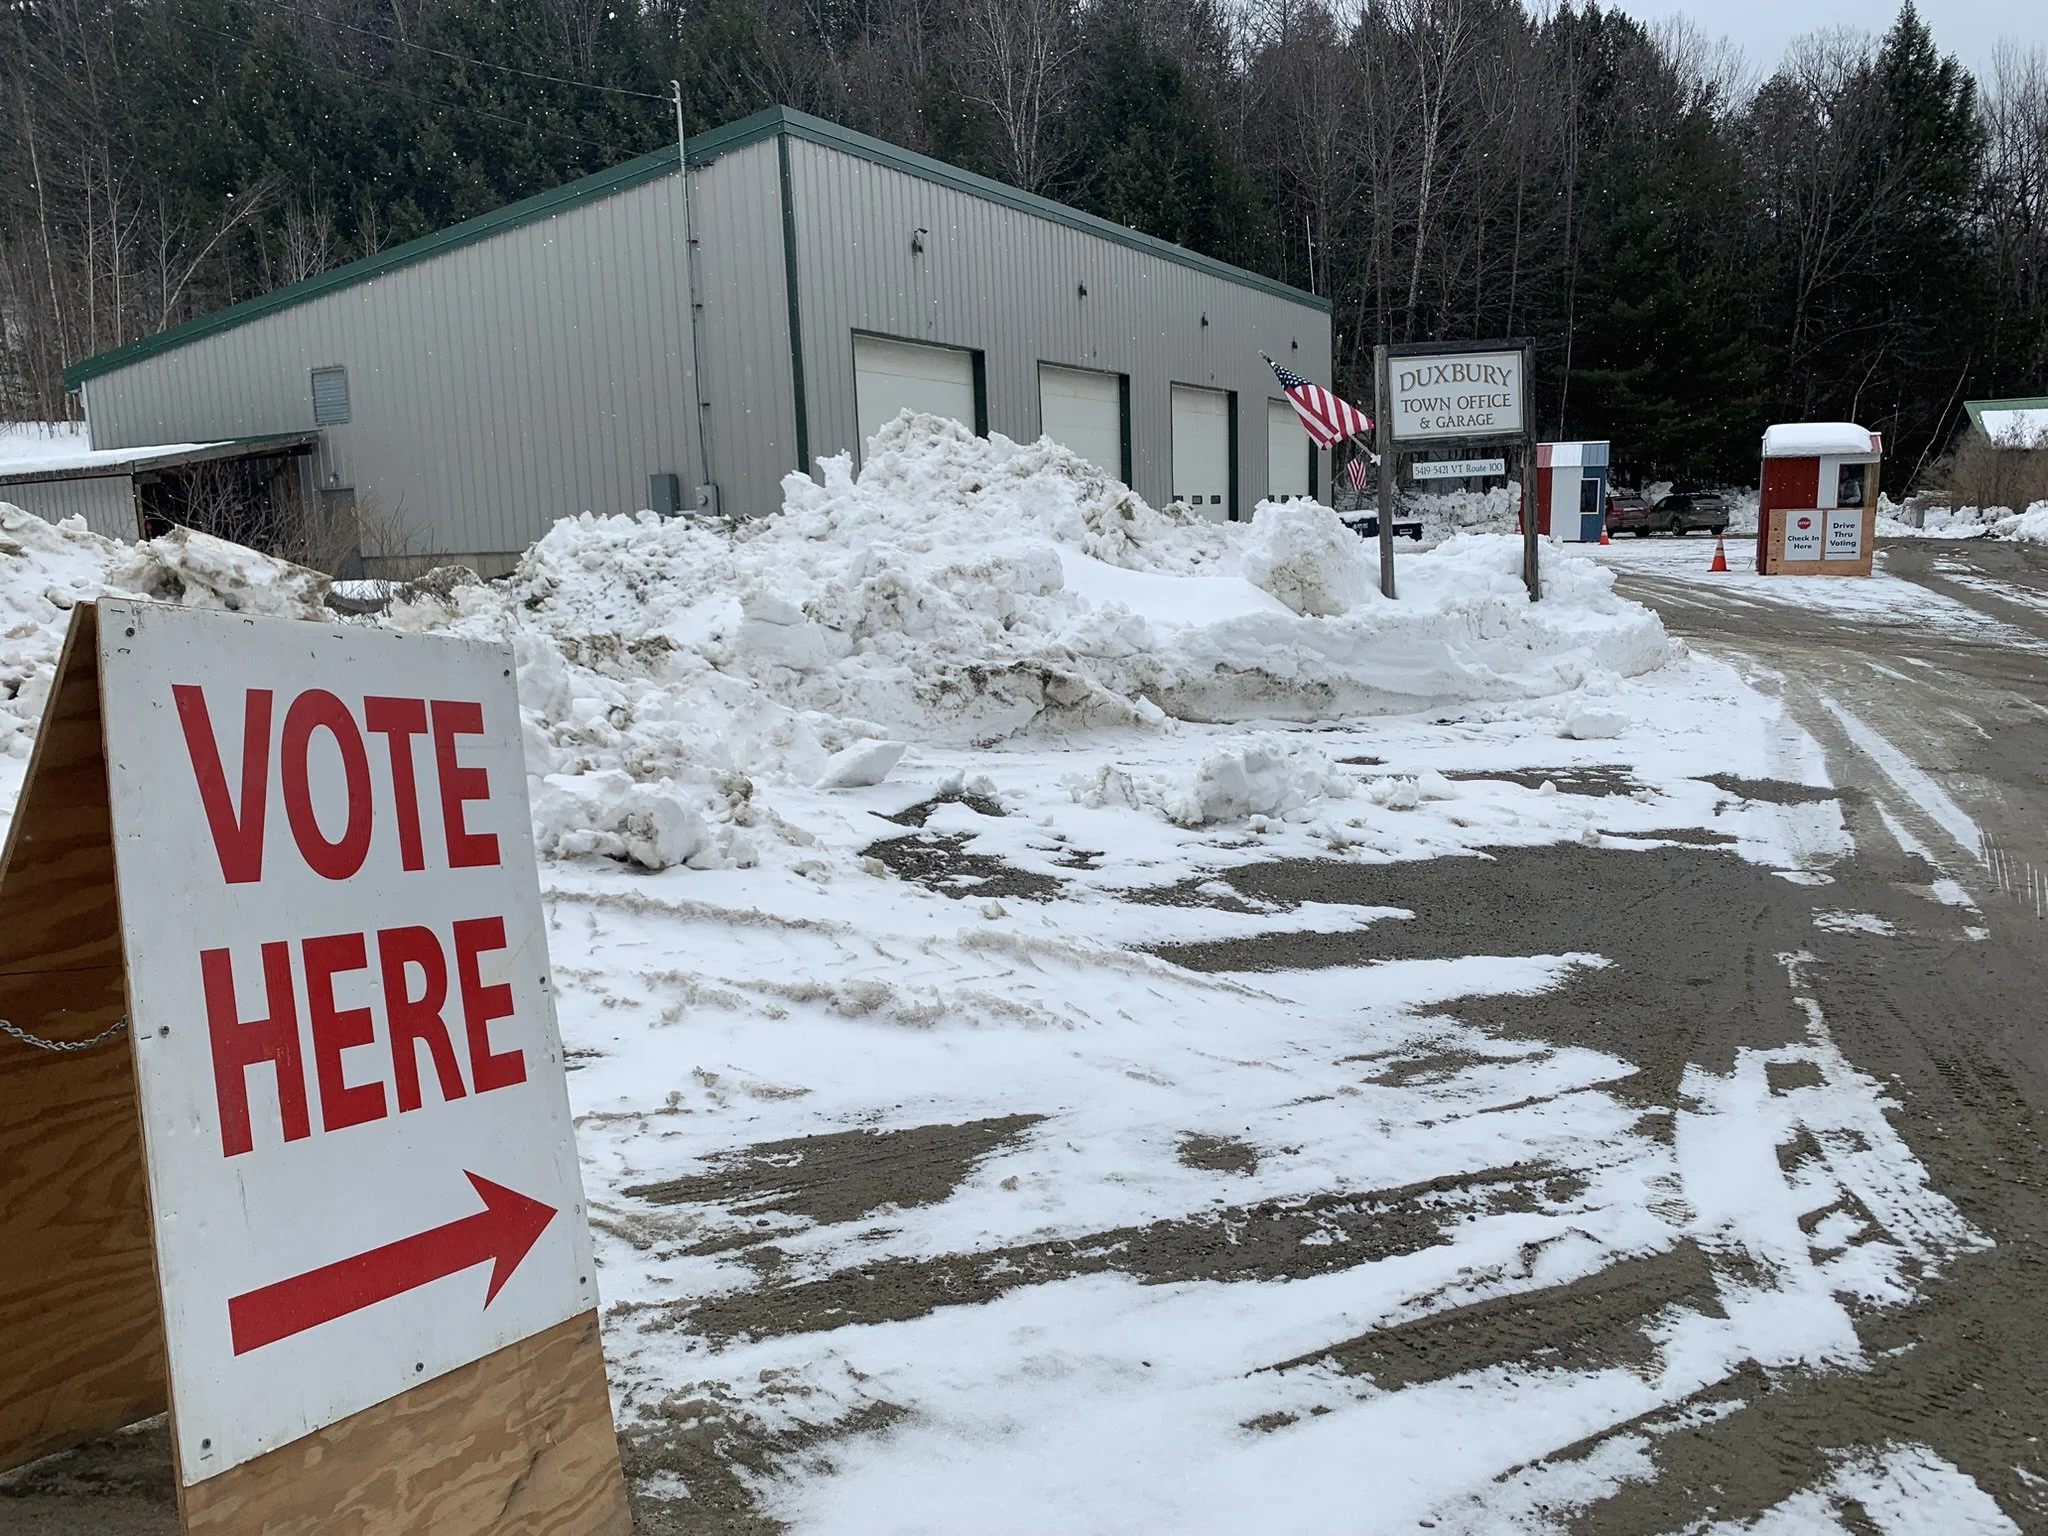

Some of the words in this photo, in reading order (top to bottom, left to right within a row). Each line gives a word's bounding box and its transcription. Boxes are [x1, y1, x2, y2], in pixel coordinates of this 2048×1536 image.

[1400, 363, 1512, 393] DUXBURY
[1401, 397, 1451, 413] TOWN
[1457, 393, 1512, 410] OFFICE
[1420, 417, 1430, 429] &
[1436, 413, 1494, 428] GARAGE
[1451, 464, 1463, 473] VT
[1466, 463, 1486, 473] Route
[1489, 462, 1503, 472] 100
[172, 684, 500, 883] VOTE
[200, 916, 527, 1158] HERE
